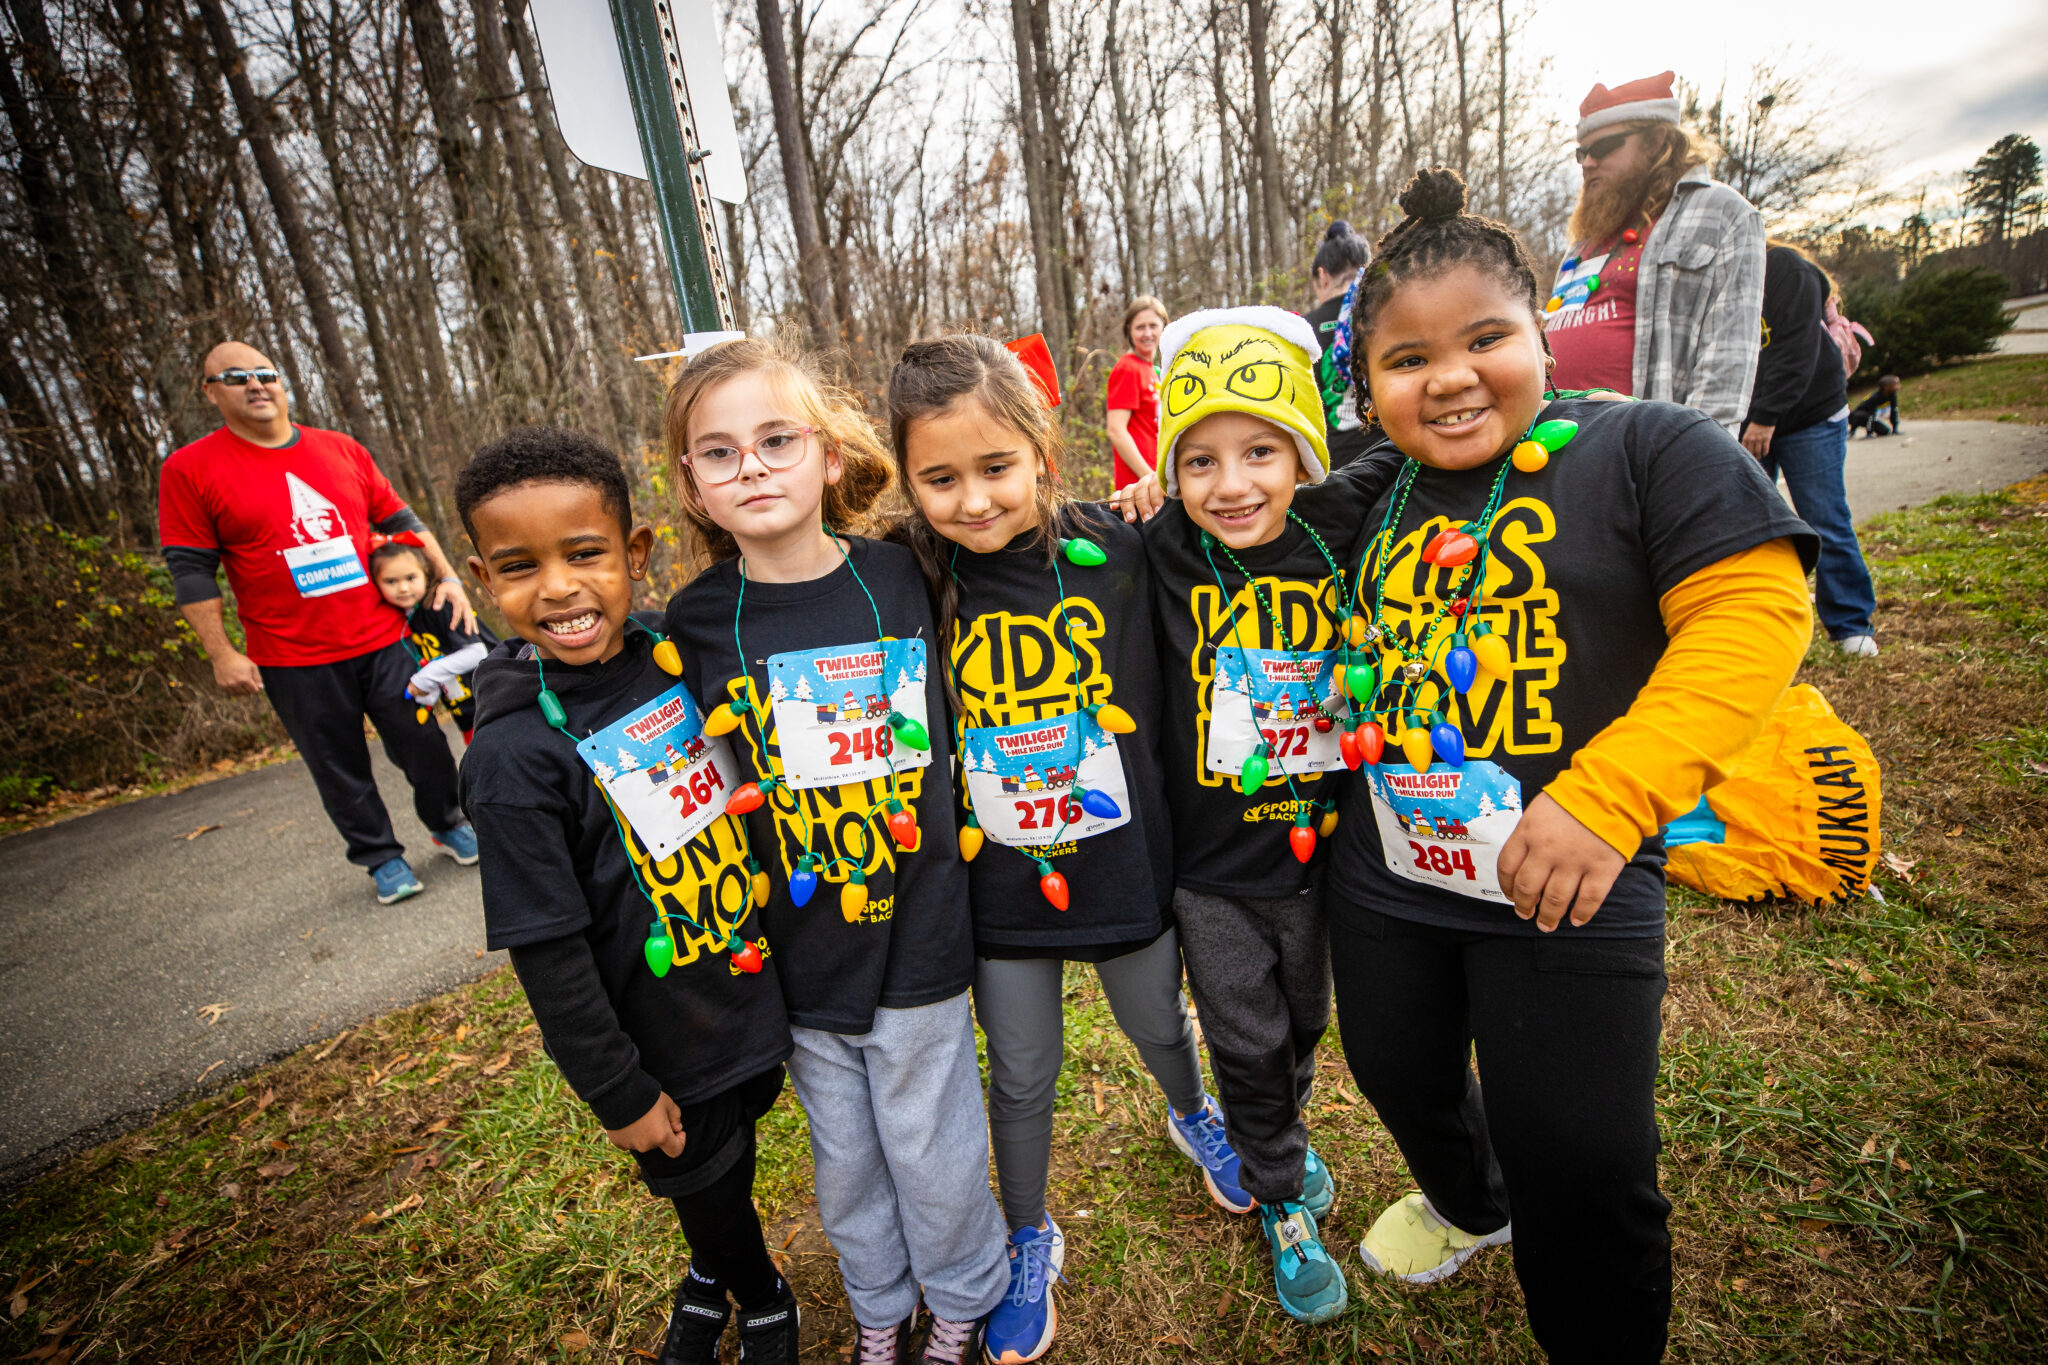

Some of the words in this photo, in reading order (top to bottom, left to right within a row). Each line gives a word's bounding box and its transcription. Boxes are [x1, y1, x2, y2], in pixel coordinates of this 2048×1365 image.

[297, 561, 361, 587] COMPANION
[816, 653, 886, 673] TWILIGHT
[825, 672, 849, 681] 1-MILE
[625, 698, 684, 739] TWILIGHT
[641, 726, 662, 743] 1-MILE
[662, 720, 674, 732] KIDS
[674, 713, 685, 723] RUN
[828, 725, 893, 766] 248
[996, 726, 1066, 749] TWILIGHT
[1005, 747, 1027, 756] 1-MILE
[1029, 744, 1045, 752] KIDS
[1047, 741, 1063, 749] RUN
[1260, 727, 1309, 759] 272
[669, 760, 724, 819] 264
[1385, 774, 1461, 788] TWILIGHT
[1394, 789, 1416, 797] 1-MILE
[1014, 794, 1083, 829] 276
[1409, 840, 1476, 880] 284
[683, 1305, 722, 1318] SKECHERS
[747, 1311, 788, 1326] SKECHERS
